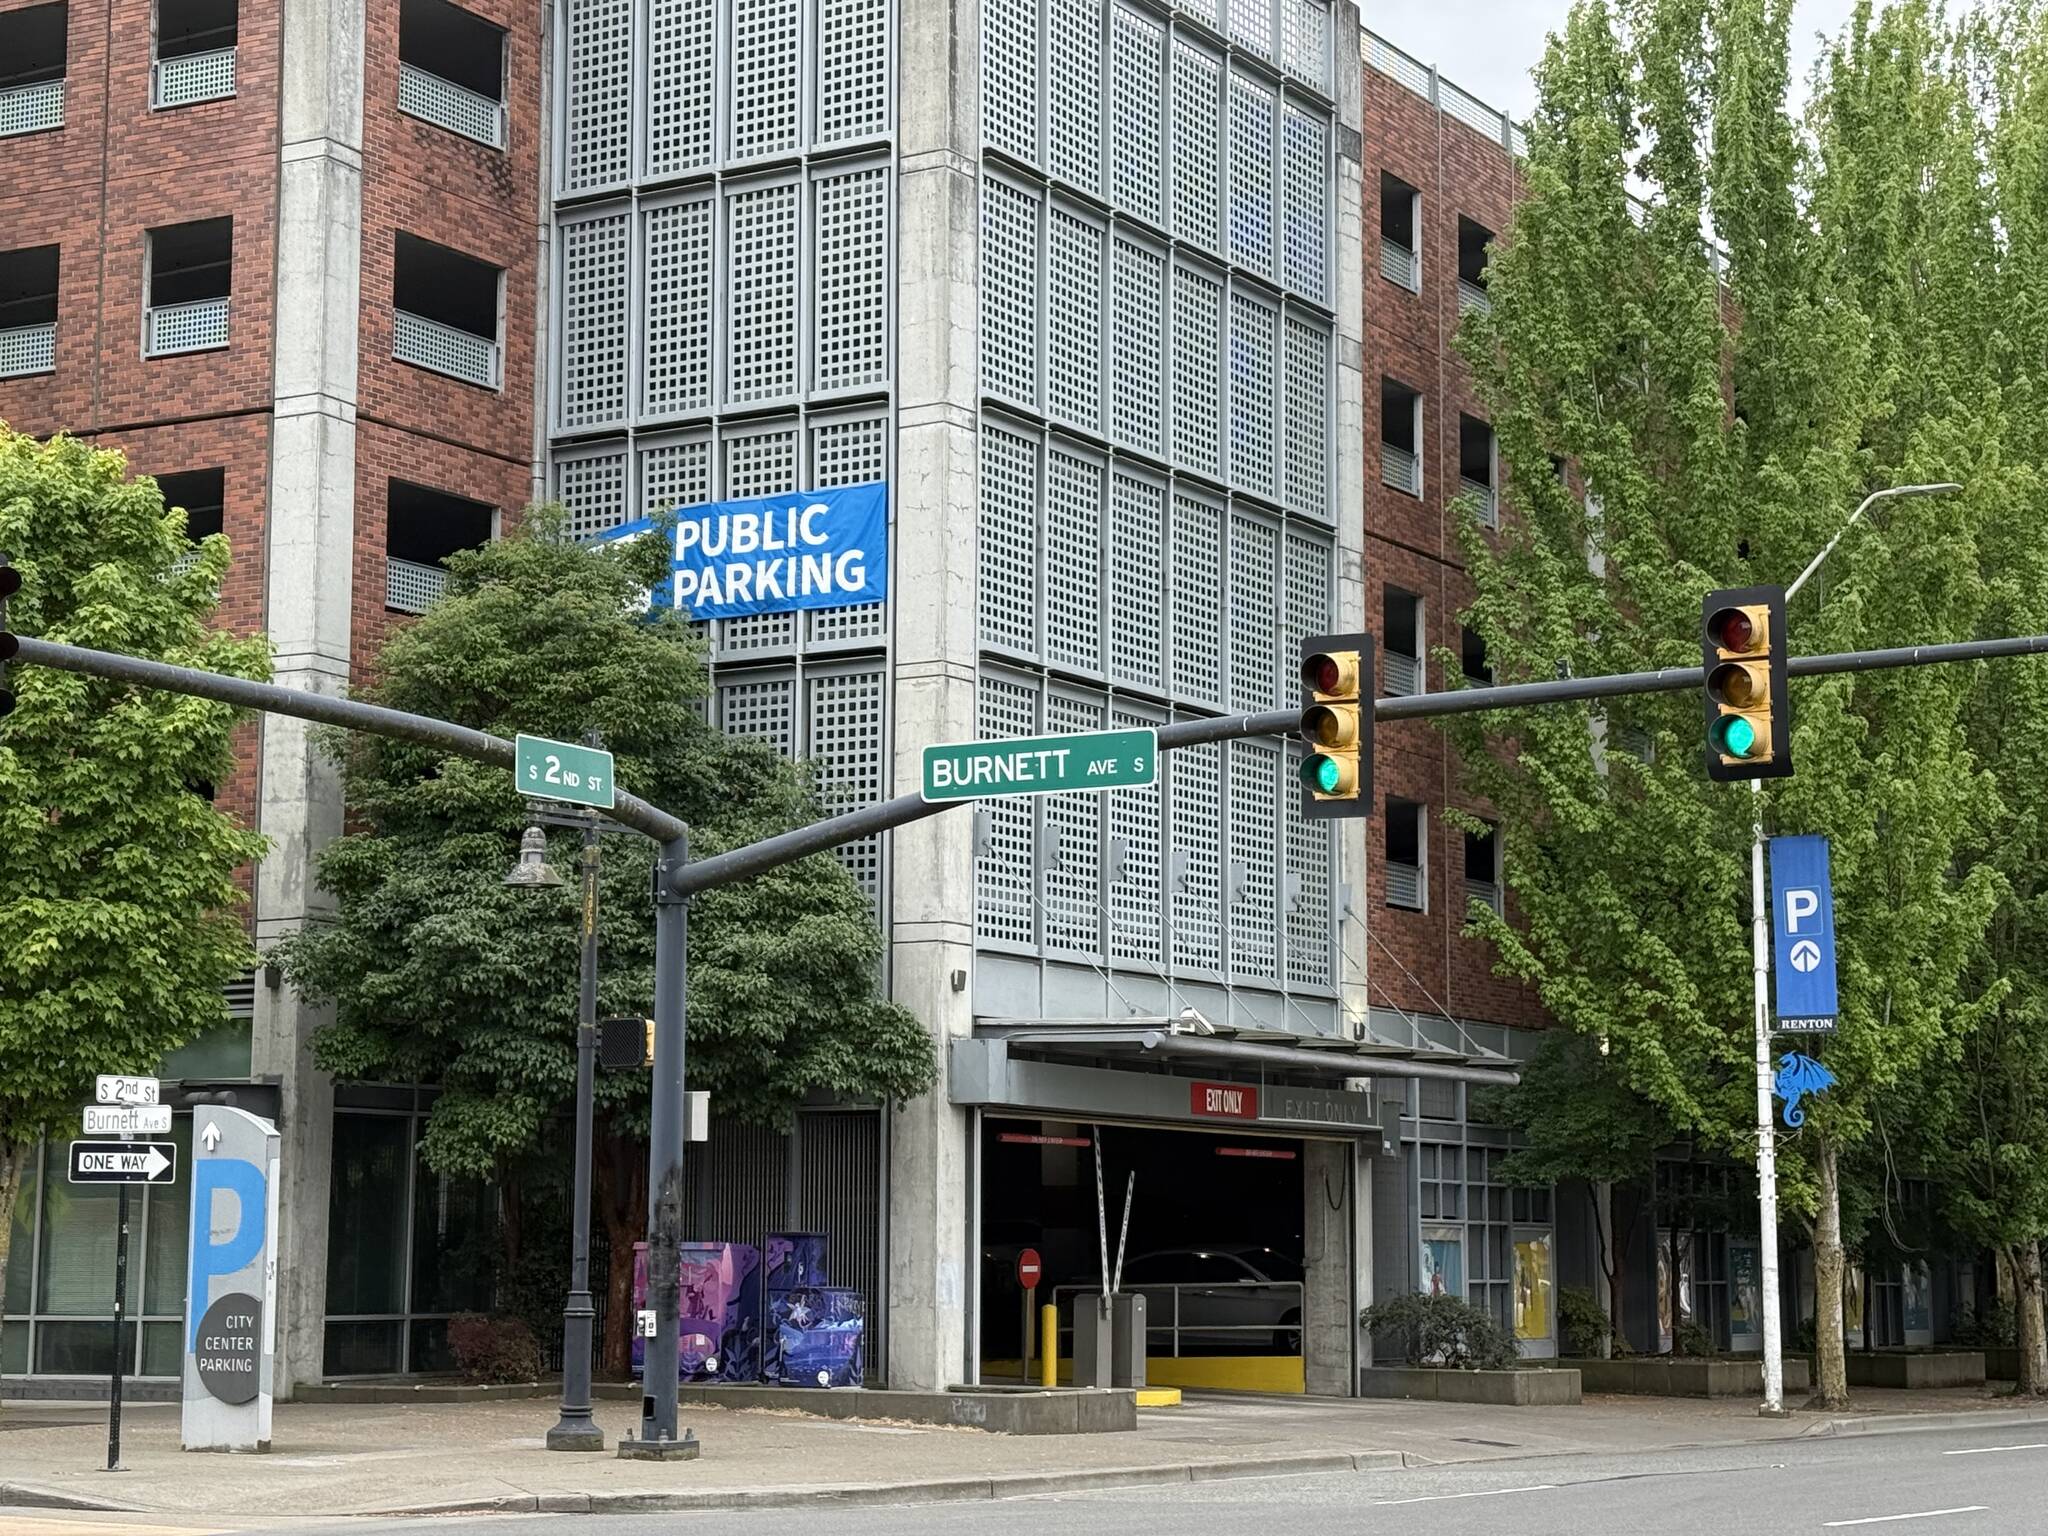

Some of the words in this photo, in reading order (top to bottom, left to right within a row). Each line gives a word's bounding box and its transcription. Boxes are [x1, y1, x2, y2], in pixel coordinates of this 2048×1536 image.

[675, 503, 830, 561] PUBLIC
[673, 549, 866, 610] PARKING
[529, 764, 538, 780] S
[545, 755, 580, 787] 2ND
[588, 776, 602, 791] ST
[932, 749, 1070, 787] BURNETT
[1087, 759, 1118, 776] AVE
[1133, 757, 1144, 773] S
[1785, 889, 1819, 934] P
[1781, 1018, 1833, 1029] RENTON
[101, 1084, 109, 1100] S
[115, 1079, 138, 1101] 2nd
[144, 1086, 156, 1103] St
[1206, 1088, 1224, 1112] EXIT
[1224, 1090, 1243, 1114] ONLY
[87, 1110, 139, 1130] Burnett
[143, 1118, 159, 1129] Ave
[161, 1119, 167, 1129] S
[1286, 1099, 1320, 1120] EXIT
[1325, 1102, 1358, 1122] ONLY
[83, 1155, 114, 1170] ONE
[120, 1155, 147, 1170] WAY
[189, 1159, 266, 1354] P
[226, 1315, 254, 1329] CITY
[205, 1336, 253, 1350] CENTER
[200, 1358, 252, 1372] PARKING
